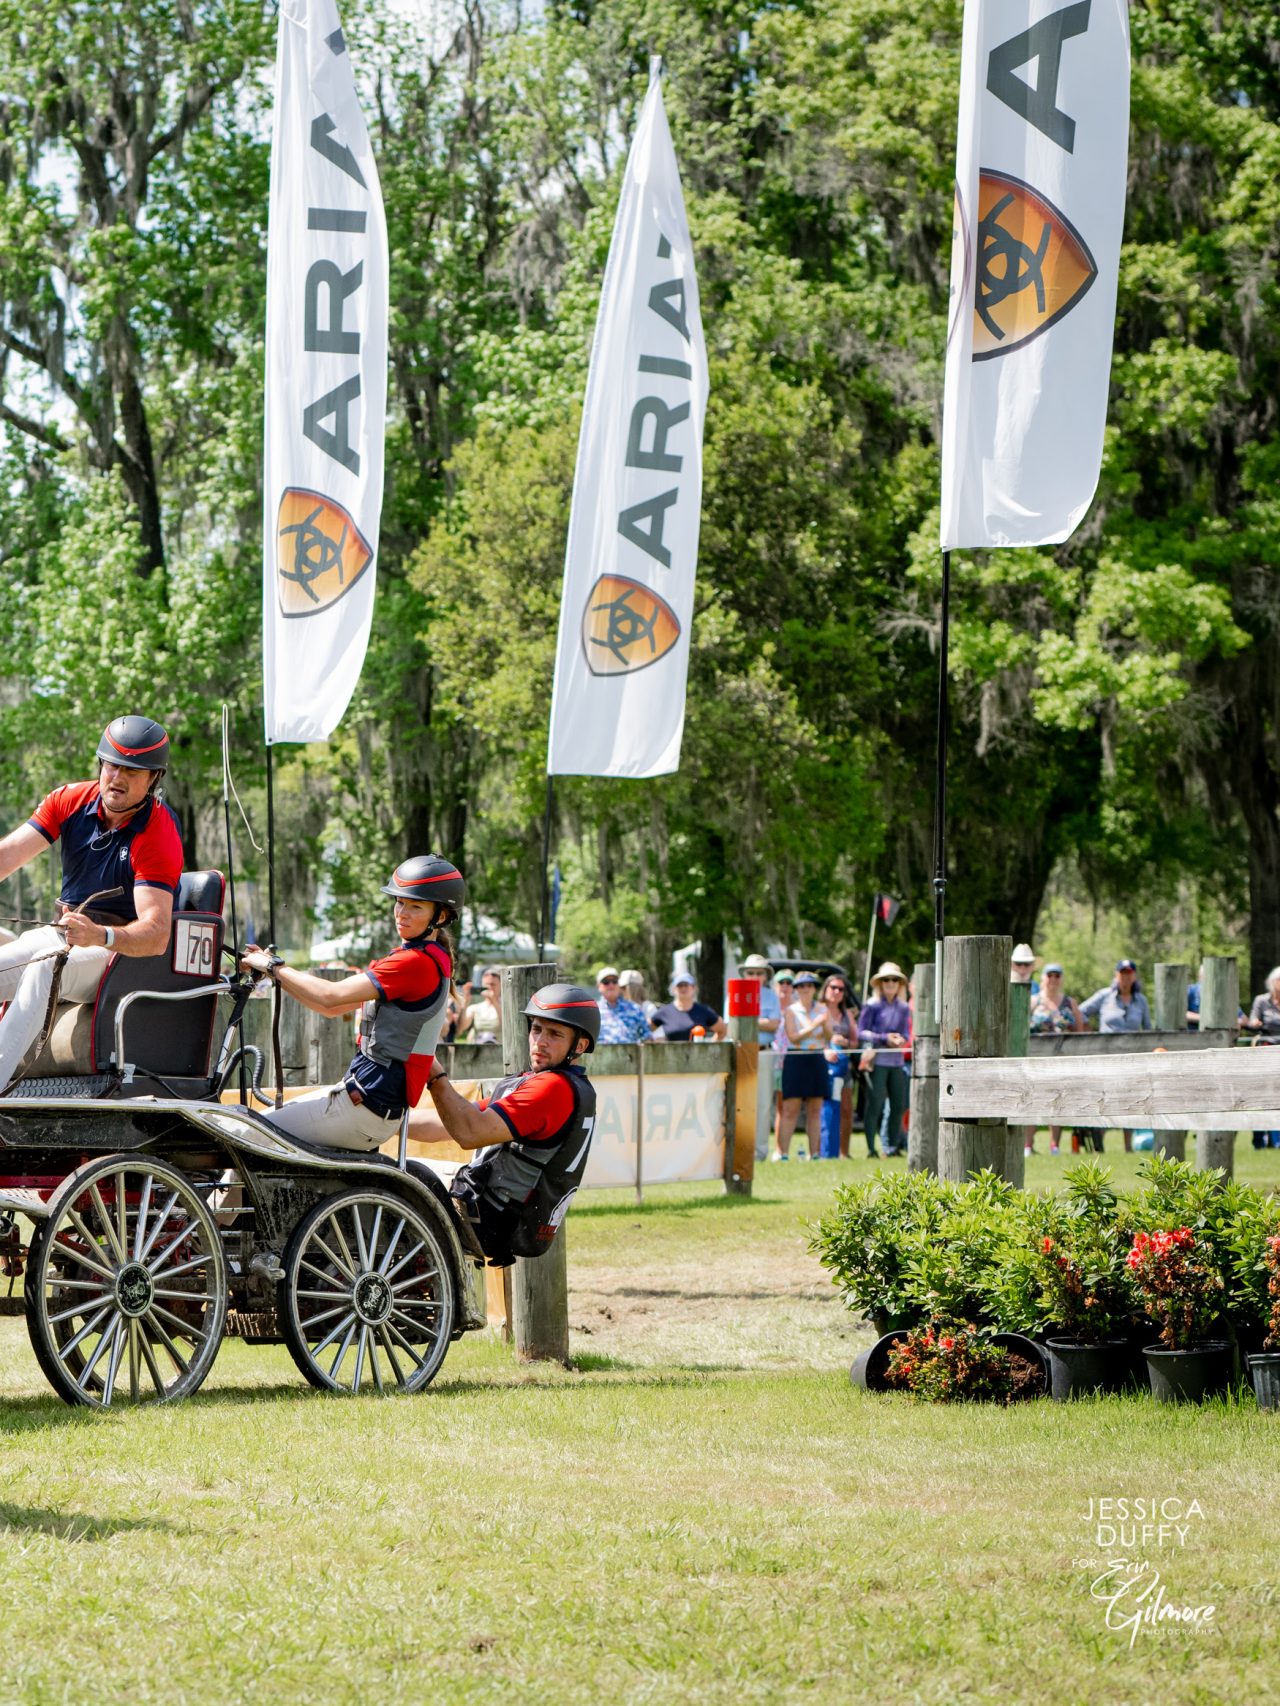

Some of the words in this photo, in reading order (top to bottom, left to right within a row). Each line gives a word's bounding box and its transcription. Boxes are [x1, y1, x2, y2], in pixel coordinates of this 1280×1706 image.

[303, 27, 368, 477] ARIA
[617, 232, 692, 569] ARIA
[188, 935, 213, 966] 70
